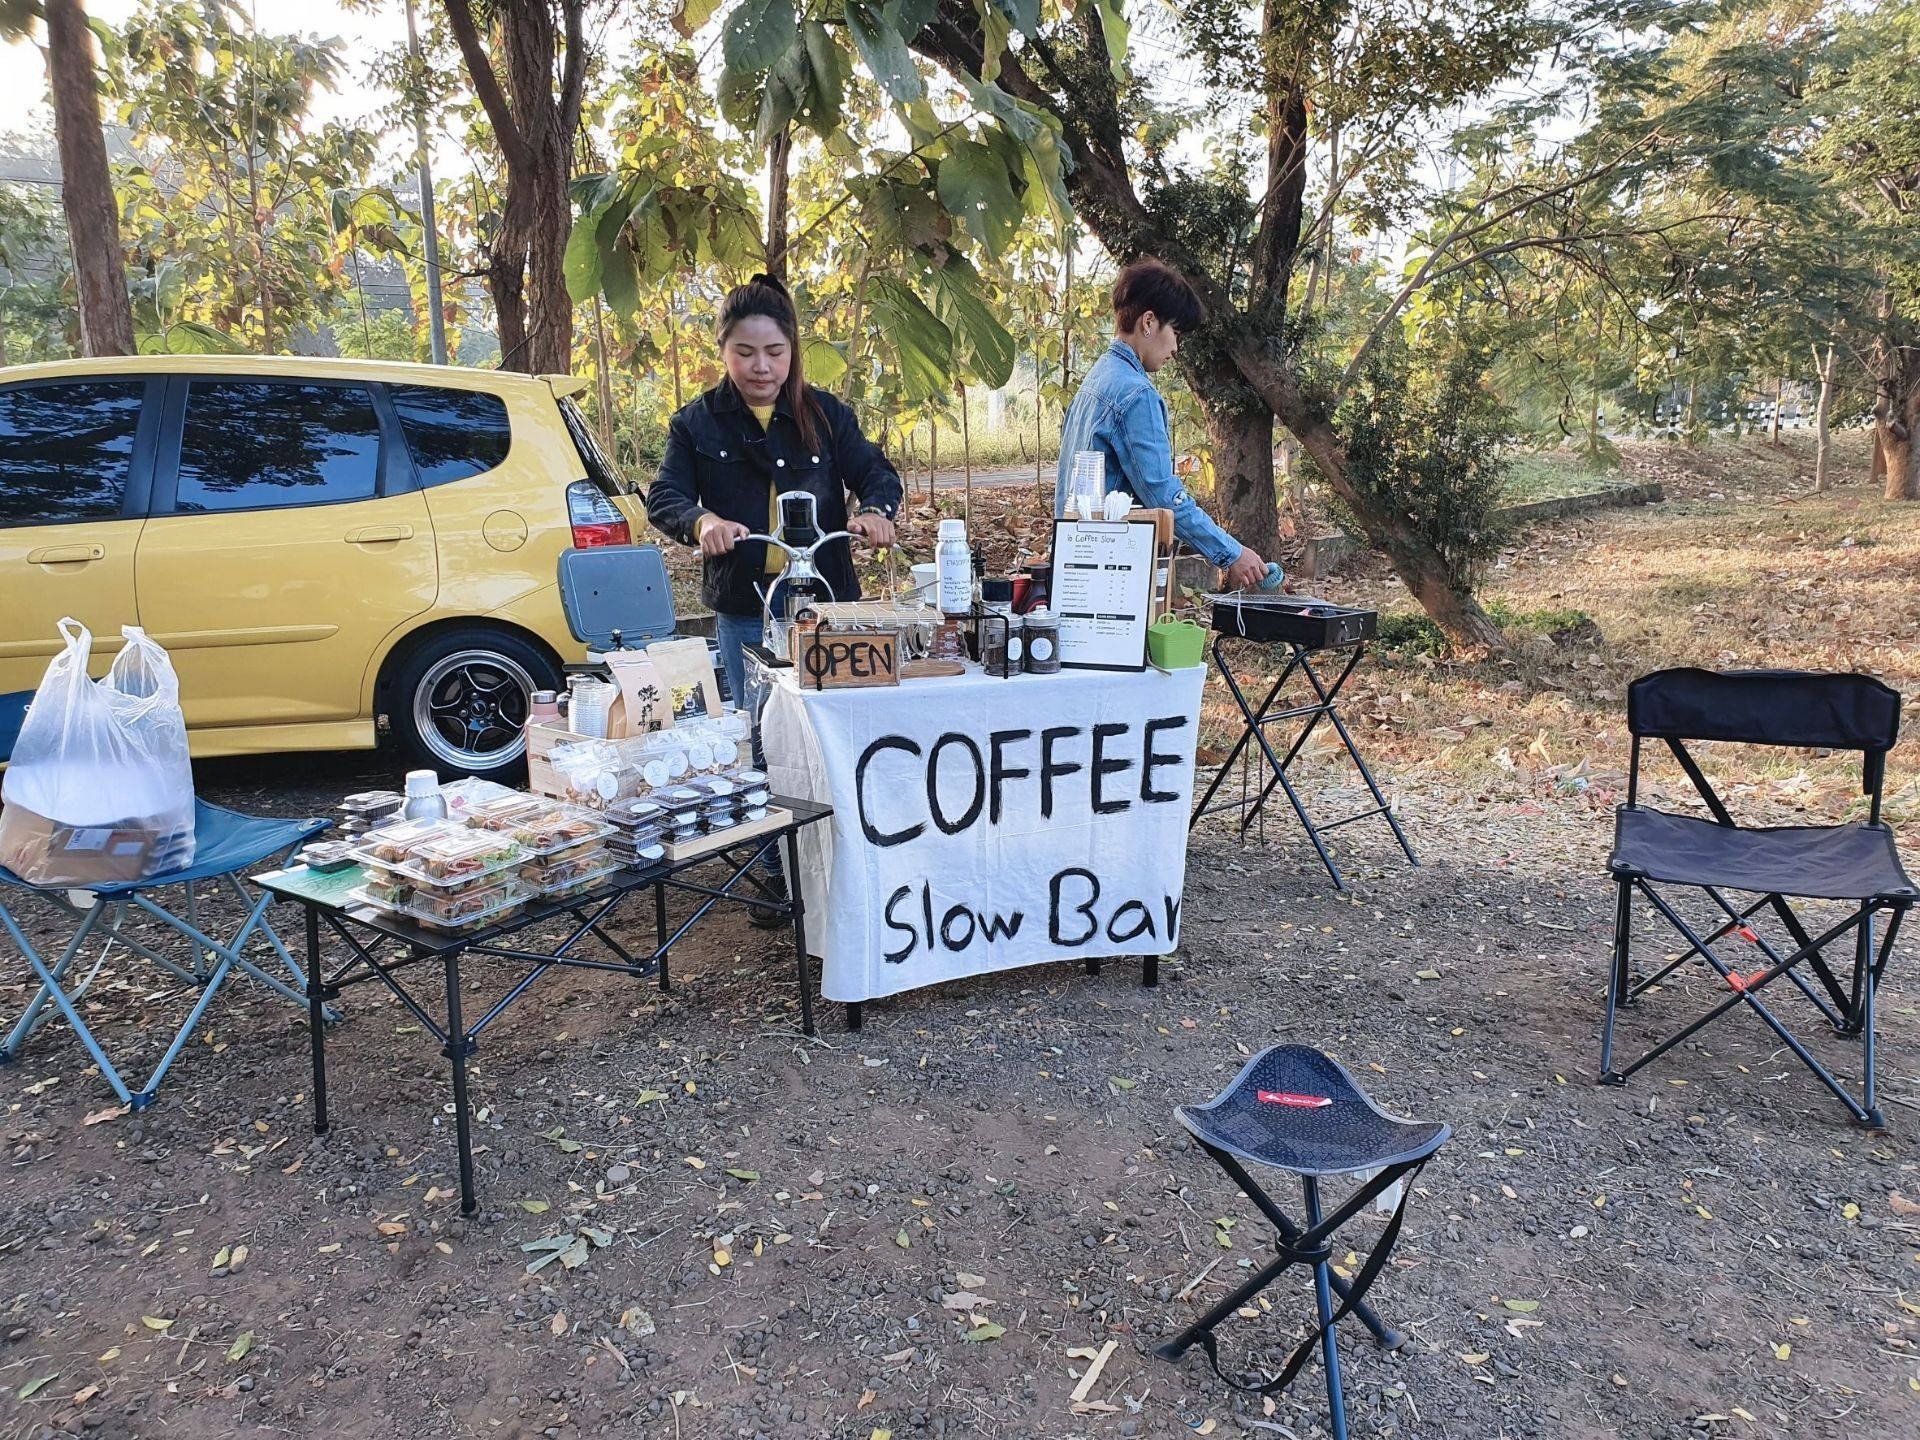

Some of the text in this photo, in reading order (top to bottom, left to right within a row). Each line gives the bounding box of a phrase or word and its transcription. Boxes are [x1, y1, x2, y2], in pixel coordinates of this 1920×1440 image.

[805, 642, 892, 677] OPEN
[855, 715, 1188, 847] COFFEE
[884, 876, 1025, 965] Slow
